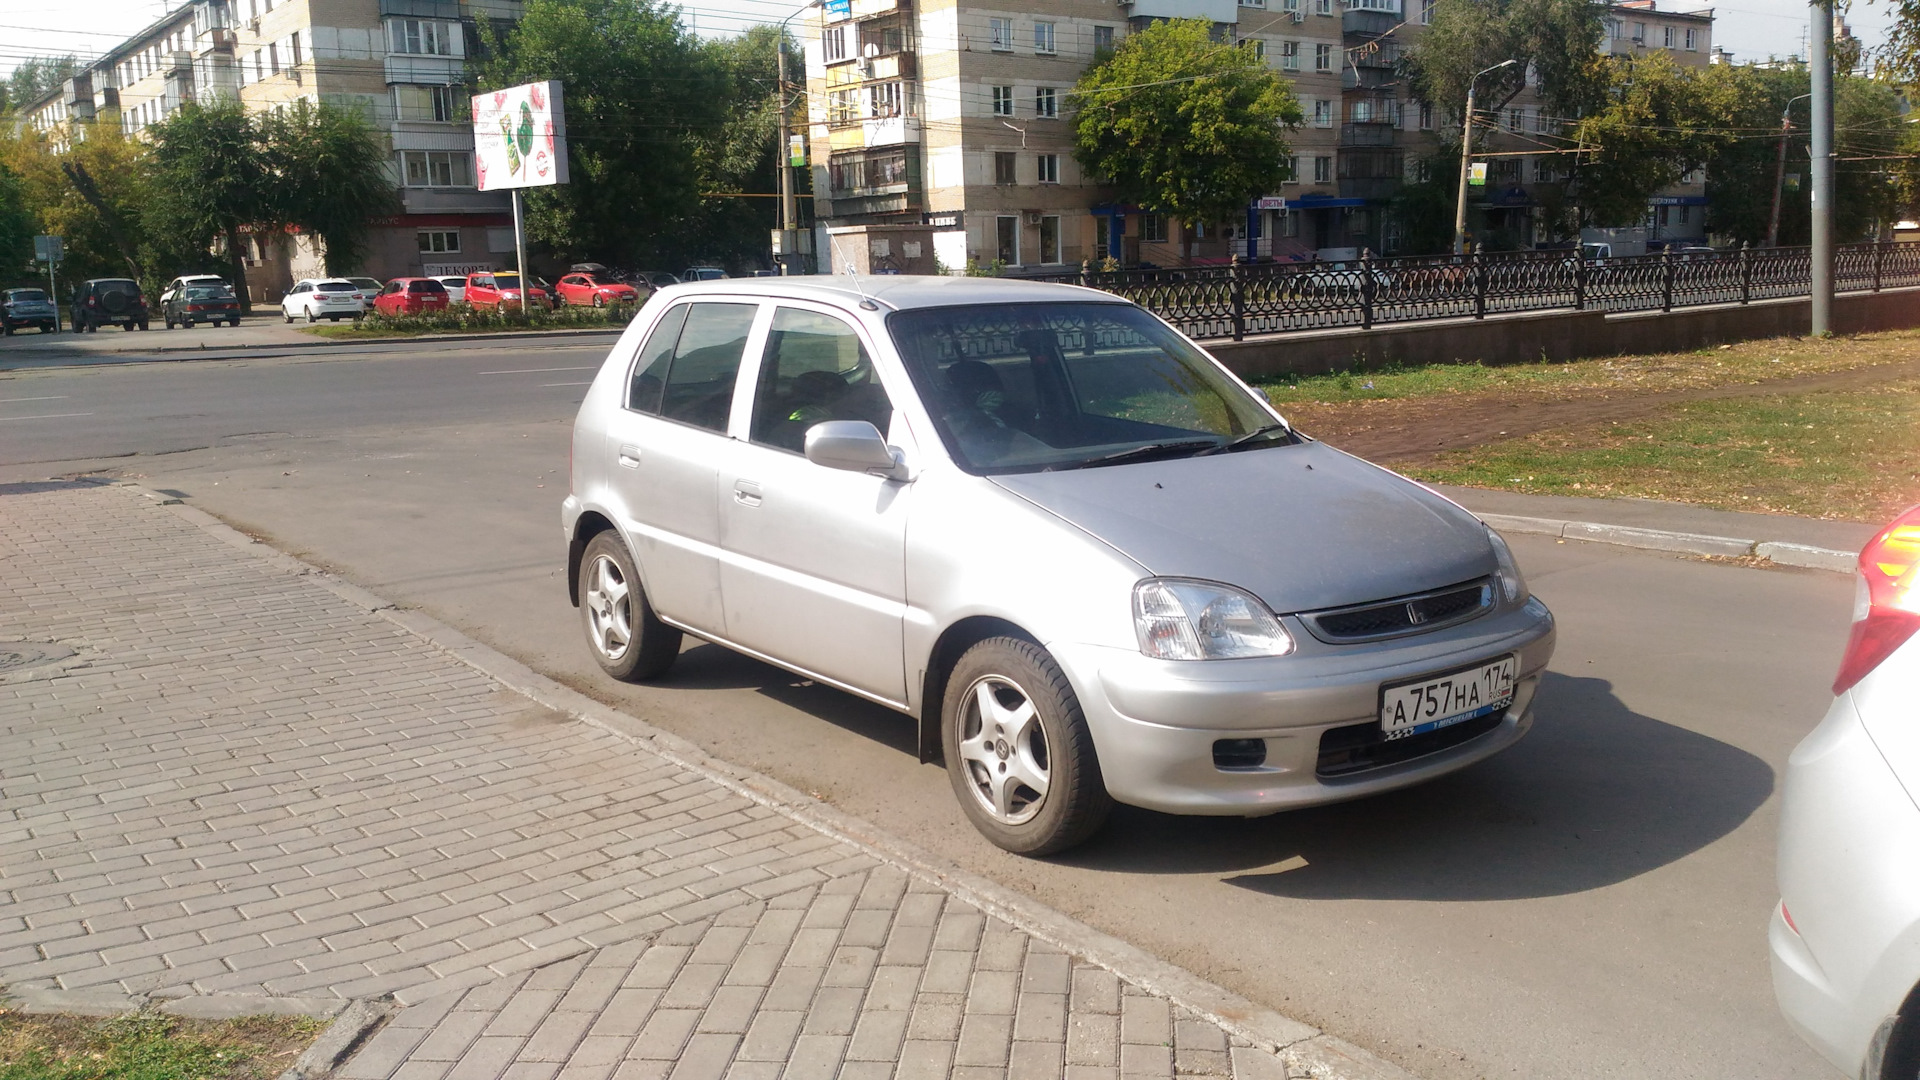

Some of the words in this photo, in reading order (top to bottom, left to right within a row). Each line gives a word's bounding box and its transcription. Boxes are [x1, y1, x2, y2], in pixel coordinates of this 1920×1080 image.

[1393, 681, 1479, 725] А757НА
[1484, 663, 1513, 692] 174
[1489, 688, 1501, 700] RUS
[1438, 711, 1474, 727] MICHELIN
